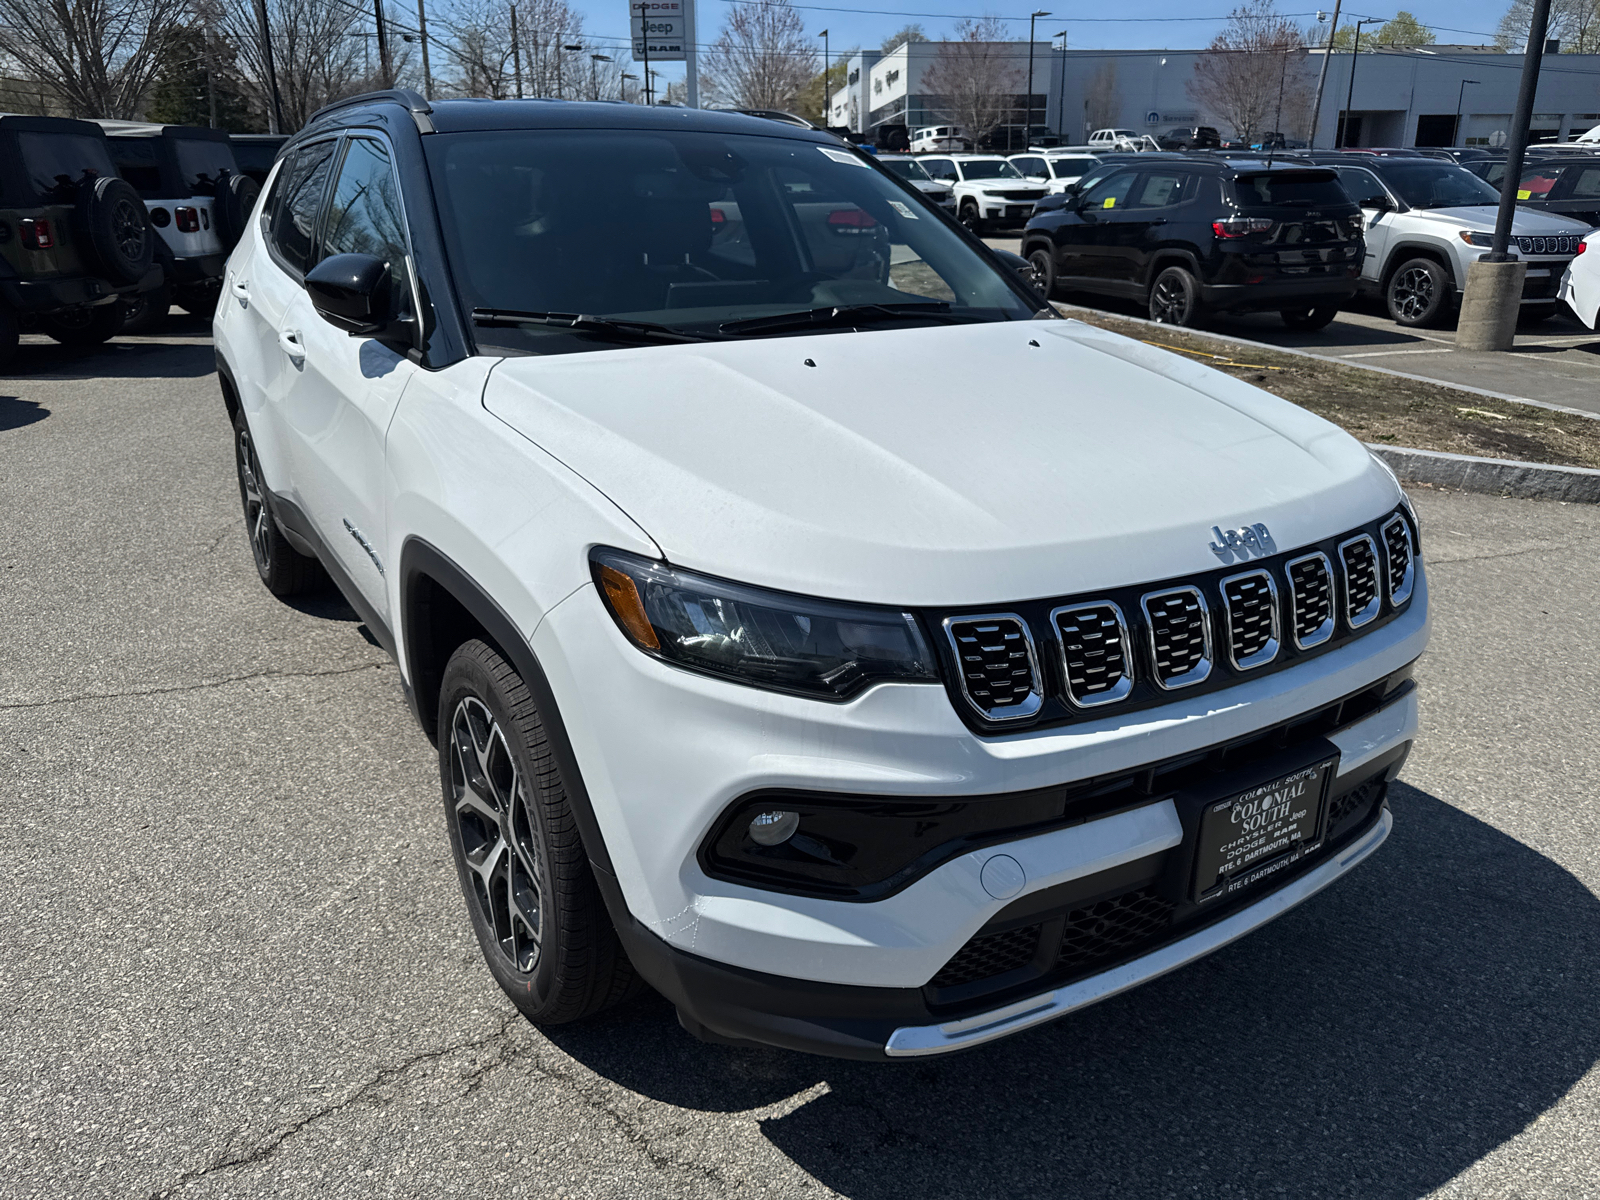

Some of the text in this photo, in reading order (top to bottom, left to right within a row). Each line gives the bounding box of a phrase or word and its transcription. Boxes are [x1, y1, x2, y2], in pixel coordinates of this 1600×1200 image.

[641, 20, 673, 35] Jeep
[1208, 522, 1271, 555] Jeep
[1319, 761, 1332, 770] Jeep
[1230, 781, 1306, 824] COLONIAL
[1239, 768, 1313, 803] COLONIAL SOUTH
[1220, 809, 1307, 852] CHRYSLER Jeep
[1241, 800, 1292, 835] SOUTH
[1218, 831, 1302, 874] RTE. 6 DARTMOUTH, MA
[1227, 823, 1298, 860] DODGE RAM
[1228, 880, 1243, 893] RTE.
[1250, 859, 1290, 883] DARTMOUTH,
[1290, 852, 1299, 863] MA
